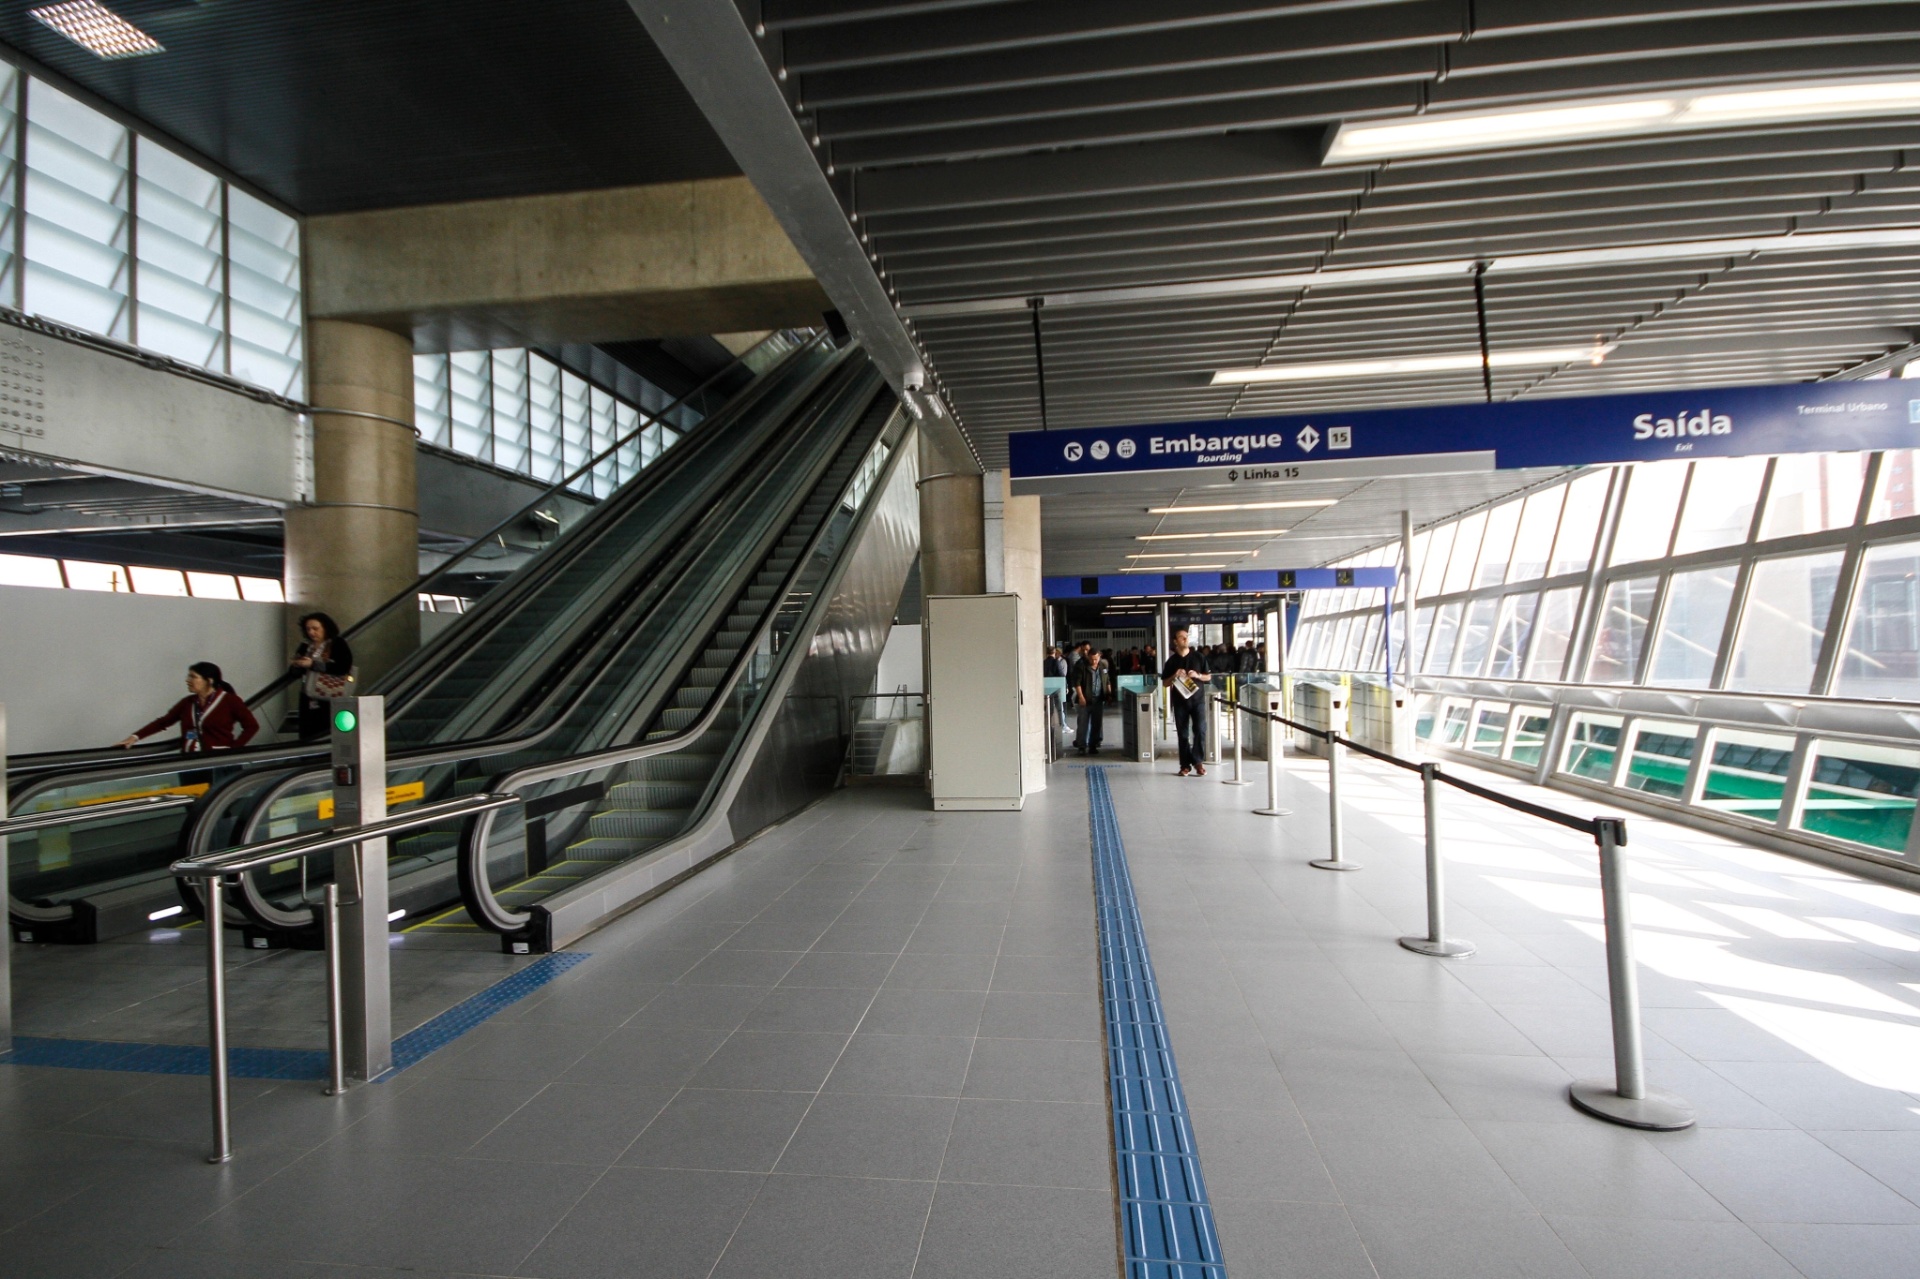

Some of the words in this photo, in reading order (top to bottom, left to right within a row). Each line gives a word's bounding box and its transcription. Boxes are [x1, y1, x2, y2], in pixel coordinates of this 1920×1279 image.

[1796, 403, 1846, 416] Terminal
[1848, 402, 1888, 412] Urbano
[1633, 409, 1732, 440] Saída
[1150, 433, 1282, 455] Embarque
[1332, 432, 1348, 443] 15
[1674, 442, 1694, 452] Exit
[1197, 452, 1243, 463] Boarding
[1244, 468, 1280, 480] Linha
[1284, 467, 1300, 478] 15
